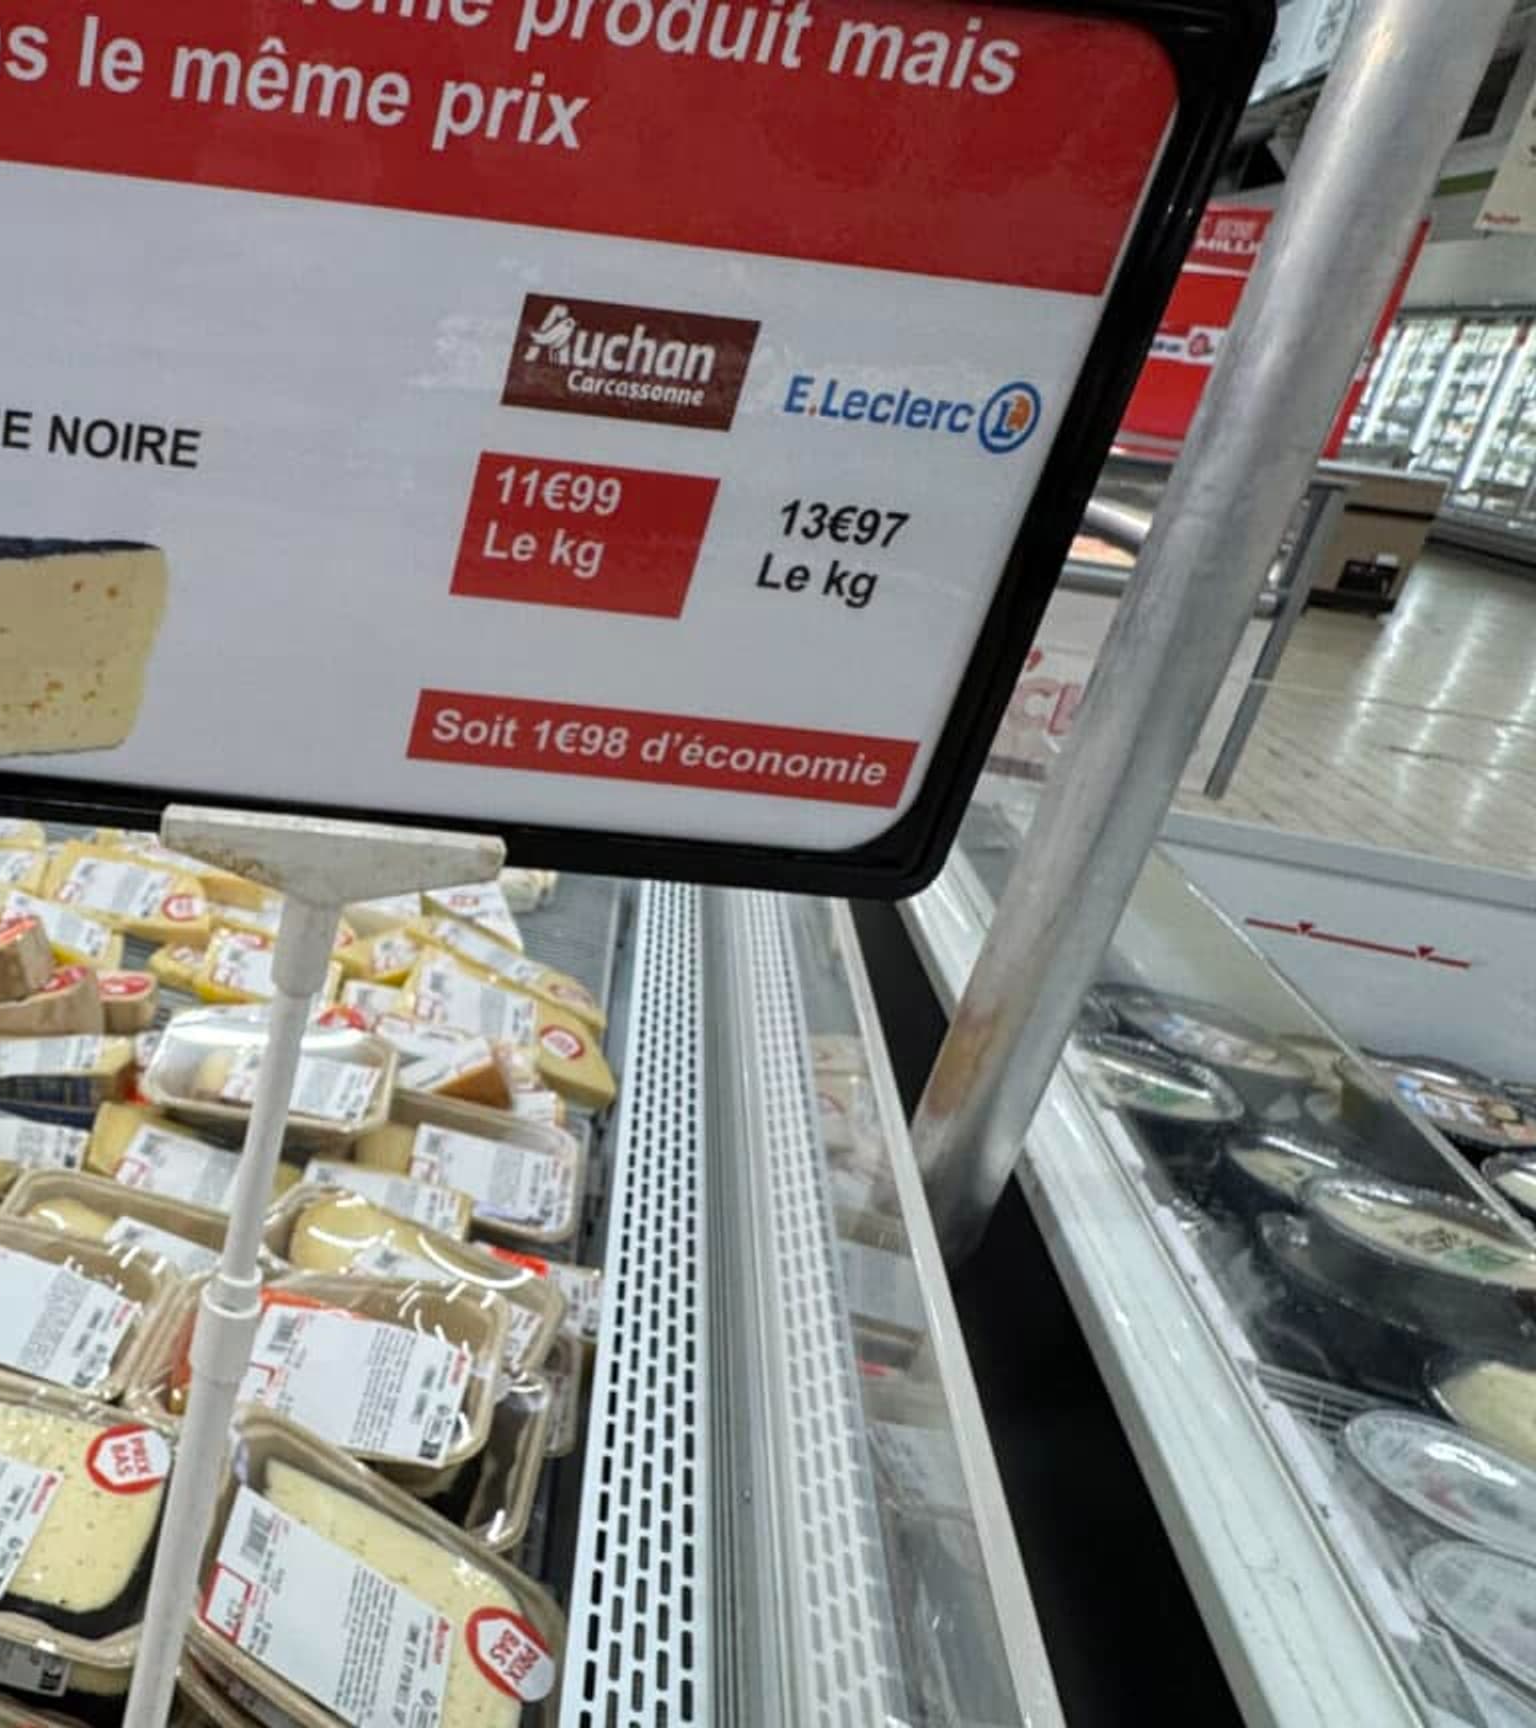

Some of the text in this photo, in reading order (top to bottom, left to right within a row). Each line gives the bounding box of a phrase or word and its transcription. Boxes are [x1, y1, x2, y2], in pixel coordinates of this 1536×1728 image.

[299, 0, 1021, 95] me produit mais
[77, 16, 144, 93] le
[170, 37, 410, 125] même
[431, 73, 590, 150] prix
[524, 304, 716, 383] Auchan
[567, 370, 705, 407] Carcassonne
[783, 374, 975, 433] E.Leclerc
[47, 414, 202, 470] NOIRE
[494, 467, 623, 517] 11€99
[482, 522, 606, 577] Le kg
[778, 499, 910, 549] 13€97
[756, 553, 879, 608] Le kg
[431, 709, 888, 787] Soit 1€98 d'économie
